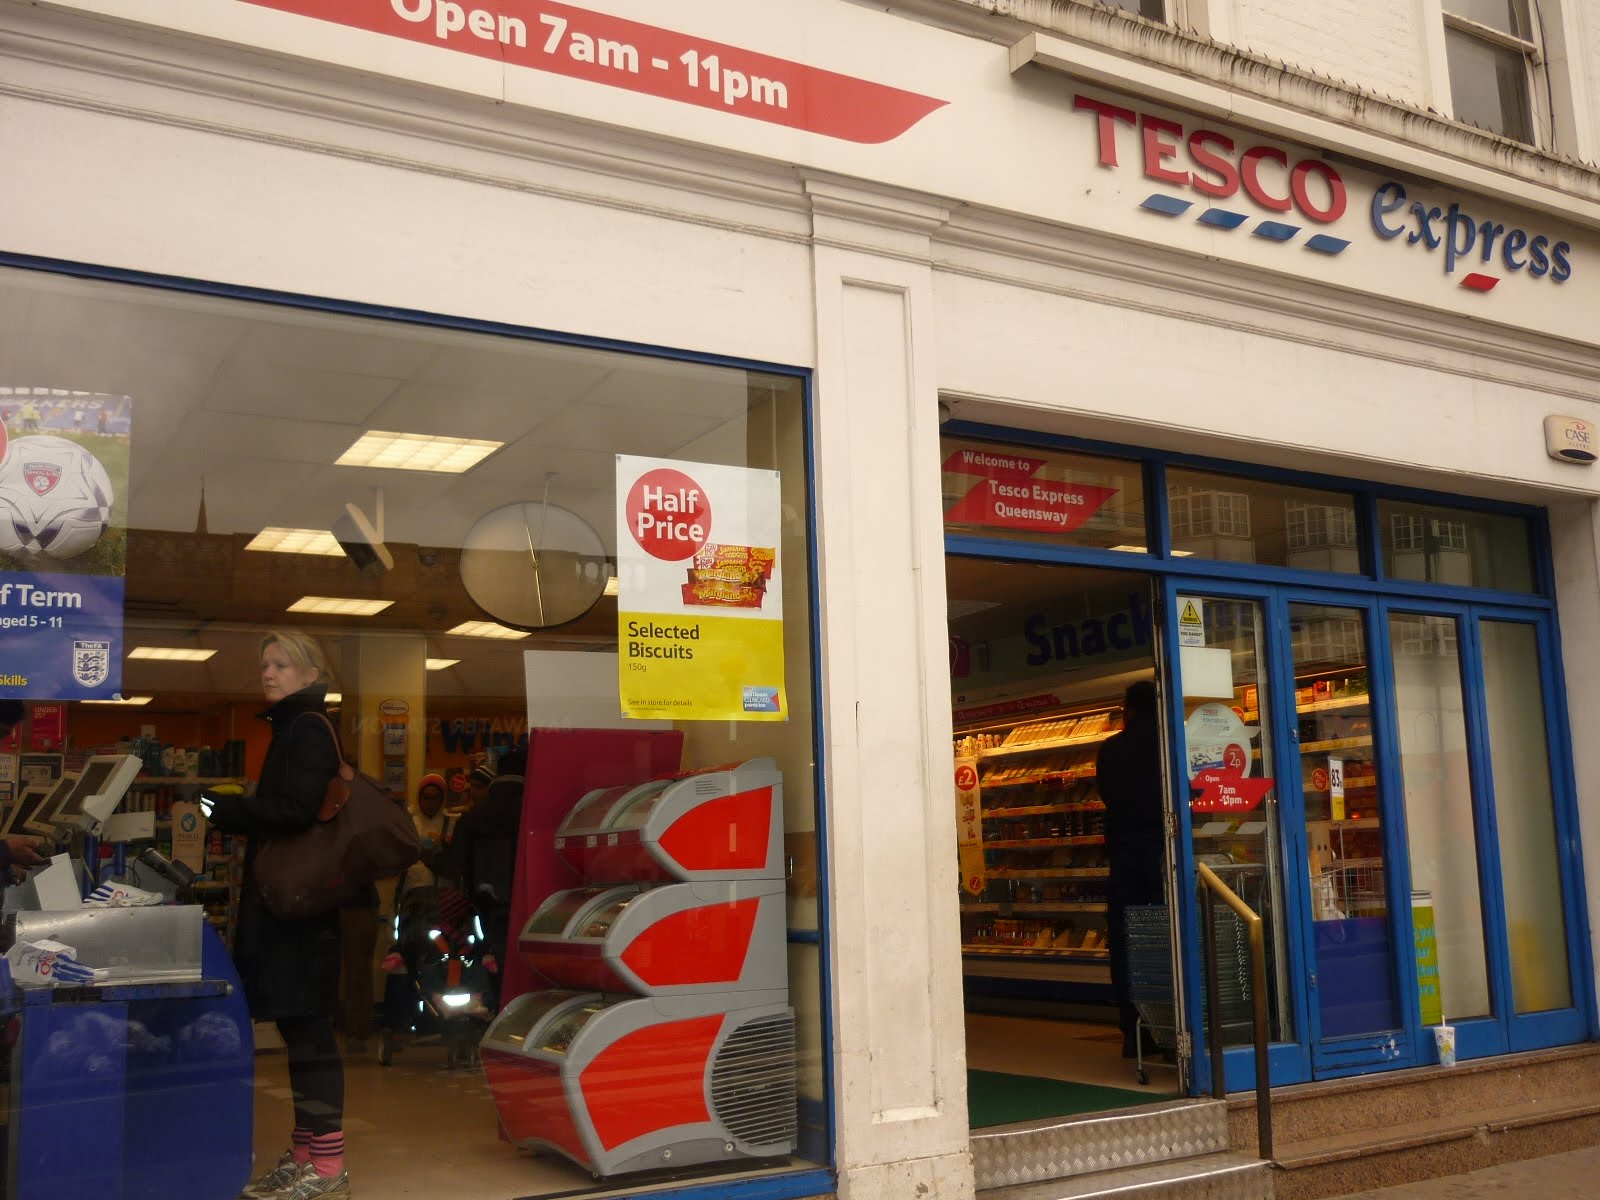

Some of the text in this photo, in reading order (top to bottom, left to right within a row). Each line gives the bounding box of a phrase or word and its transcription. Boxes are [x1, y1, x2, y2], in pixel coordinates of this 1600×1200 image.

[389, 0, 527, 48] Open
[540, 14, 639, 73] 7am
[680, 49, 788, 109] 11pm
[1075, 94, 1571, 282] TESCO express
[1565, 428, 1591, 443] CASE
[962, 451, 1030, 471] Welcome to
[643, 485, 700, 514] Half
[989, 480, 1084, 505] Tesco Express
[995, 502, 1068, 525] Queensway
[637, 513, 704, 542] Price
[15, 584, 82, 608] Term
[699, 589, 741, 601] Maryland
[0, 615, 28, 629] ged
[29, 616, 39, 627] 5
[49, 616, 63, 628] 11
[628, 621, 700, 640] Selected
[628, 641, 694, 660] Biscuits
[628, 663, 647, 673] 150g
[1229, 752, 1241, 769] 2p
[957, 770, 974, 786] £2
[1204, 775, 1220, 783] Open
[1218, 785, 1236, 794] 7am
